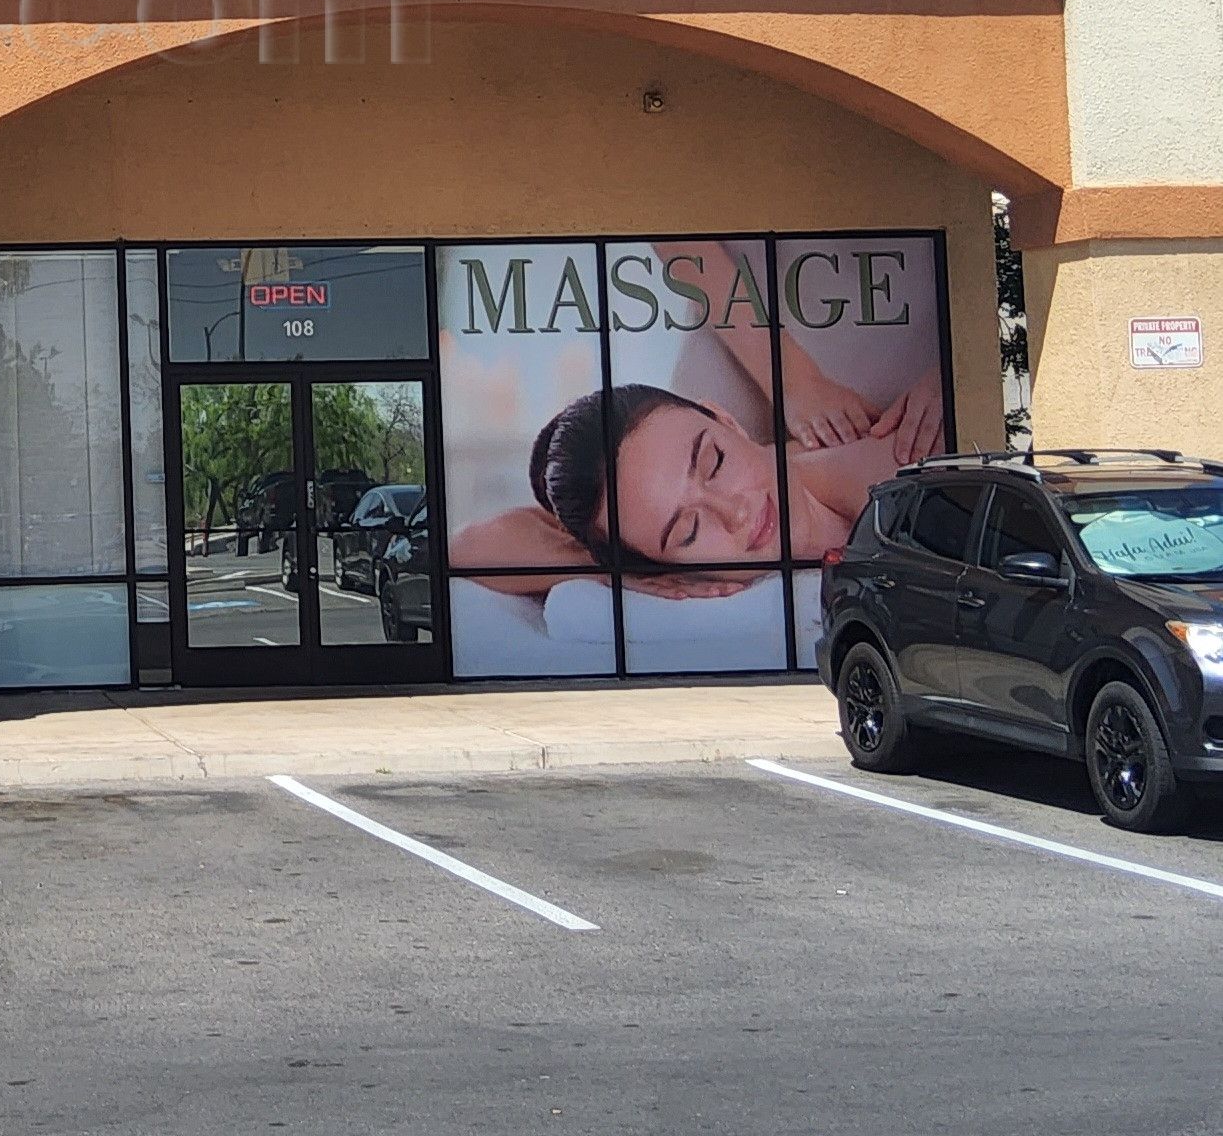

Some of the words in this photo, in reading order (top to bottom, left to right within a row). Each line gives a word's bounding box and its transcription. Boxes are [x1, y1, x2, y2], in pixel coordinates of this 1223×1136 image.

[250, 285, 326, 306] OPEN
[460, 250, 910, 334] MASSAGE
[283, 320, 314, 337] 108
[1159, 336, 1172, 345] NO
